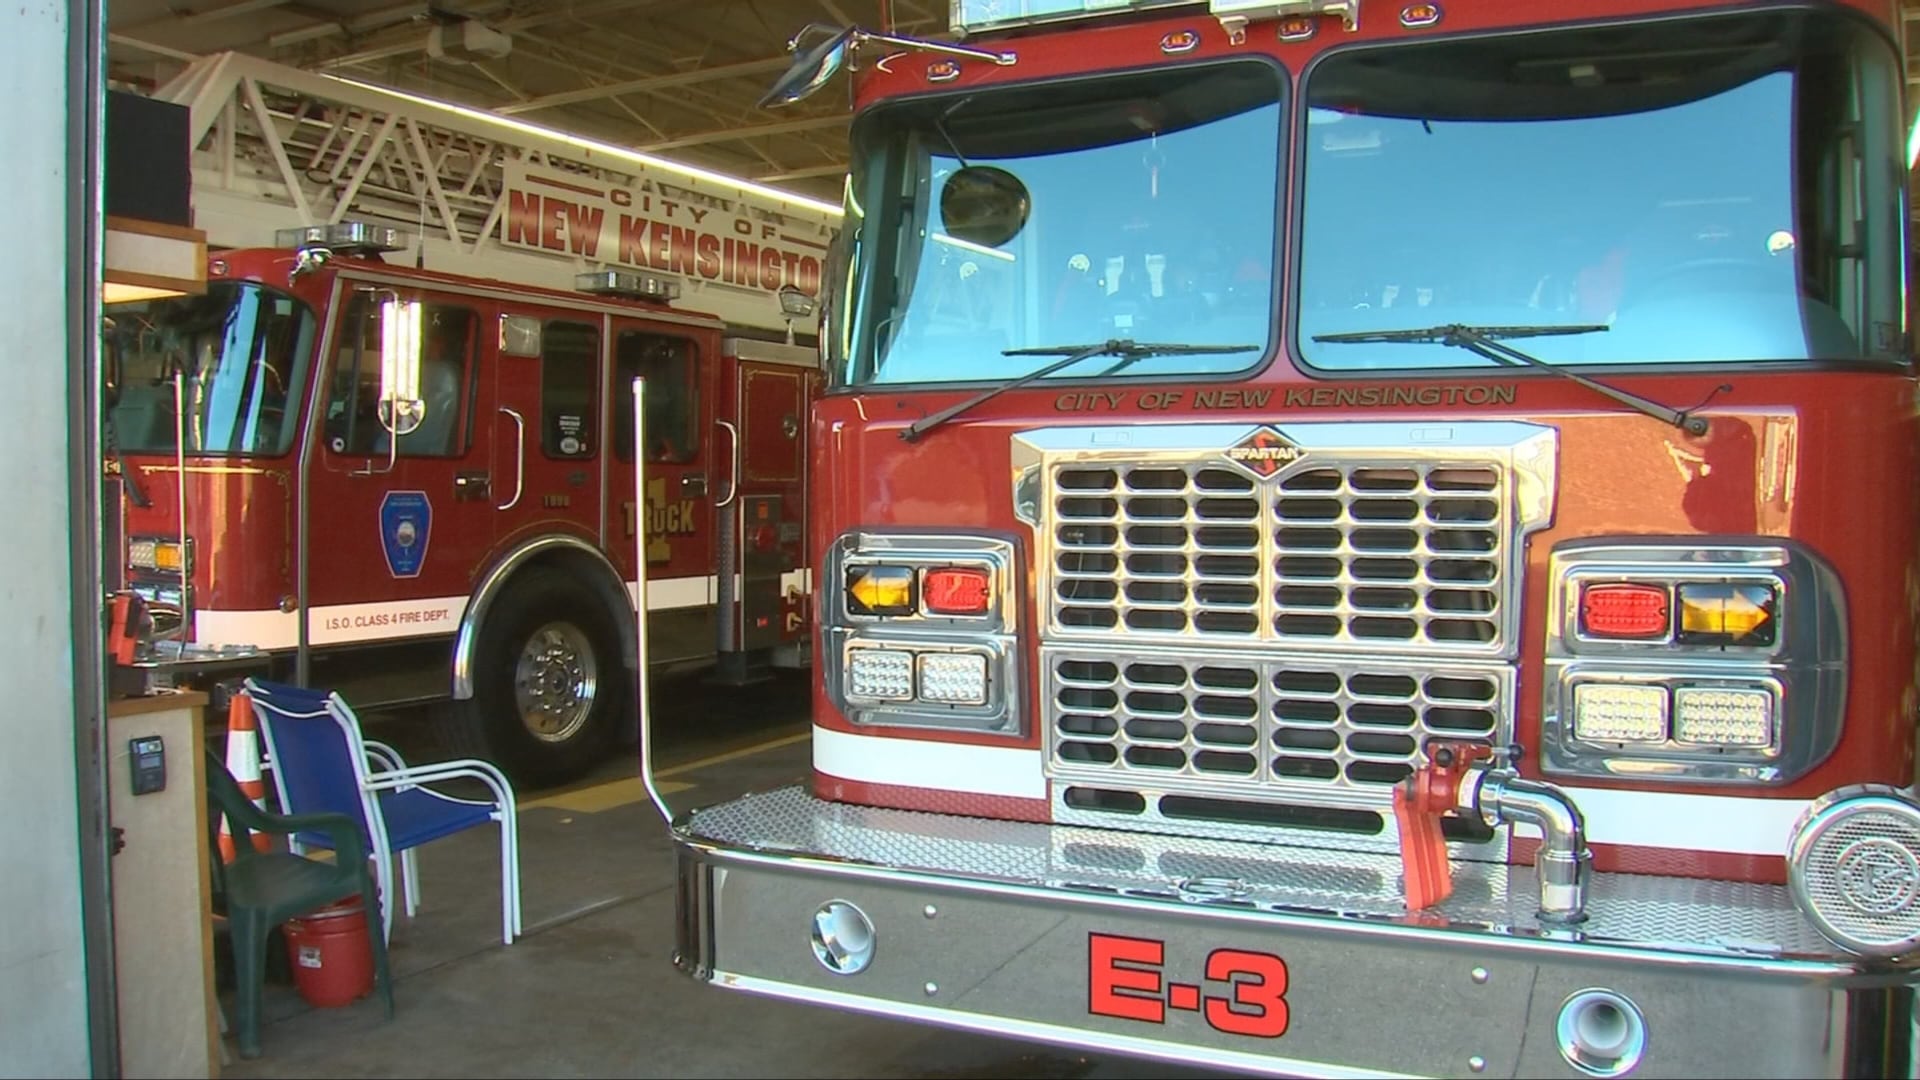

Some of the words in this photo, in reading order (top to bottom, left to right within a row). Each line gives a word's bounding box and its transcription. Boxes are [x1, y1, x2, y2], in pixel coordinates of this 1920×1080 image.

[610, 189, 708, 224] CITY
[734, 219, 777, 239] OF
[508, 189, 604, 257] NEW
[618, 214, 827, 299] KENSINGTO
[1055, 392, 1126, 411] CITY
[1137, 391, 1182, 409] OF
[1193, 390, 1272, 409] NEW
[1283, 384, 1518, 408] KENSINGTON
[1230, 447, 1298, 460] SPARTAN
[326, 617, 353, 630] I.S.O.
[354, 614, 389, 627] CLASS
[391, 614, 397, 624] 4
[399, 611, 421, 623] FIRE
[423, 609, 450, 621] DEPT.
[1088, 931, 1290, 1038] E-3
